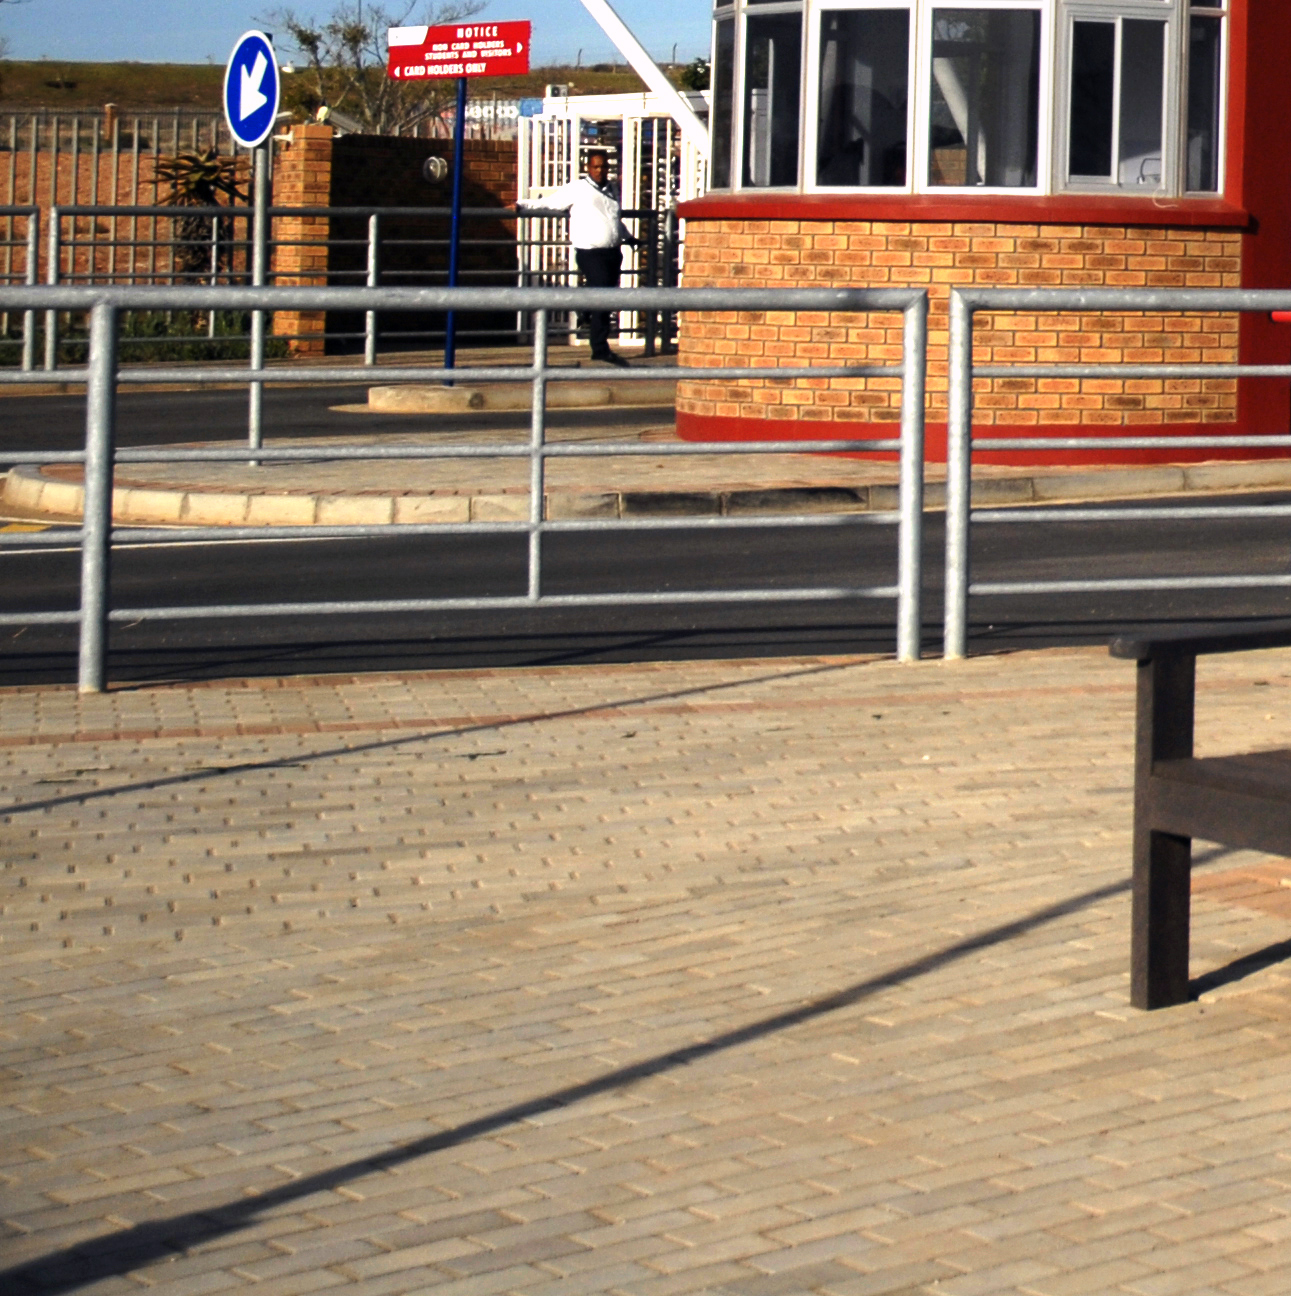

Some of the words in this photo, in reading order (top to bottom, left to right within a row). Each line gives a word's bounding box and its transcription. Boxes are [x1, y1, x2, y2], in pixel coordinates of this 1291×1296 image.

[457, 25, 498, 38] NOTICE
[451, 42, 470, 50] CARD
[473, 40, 505, 49] HOLDERS
[425, 51, 459, 60] STUDENTS
[462, 50, 477, 58] AND
[481, 48, 512, 57] VISITORS
[404, 65, 426, 77] CARD
[427, 64, 463, 75] HOLDERS
[465, 63, 487, 74] ONLY
